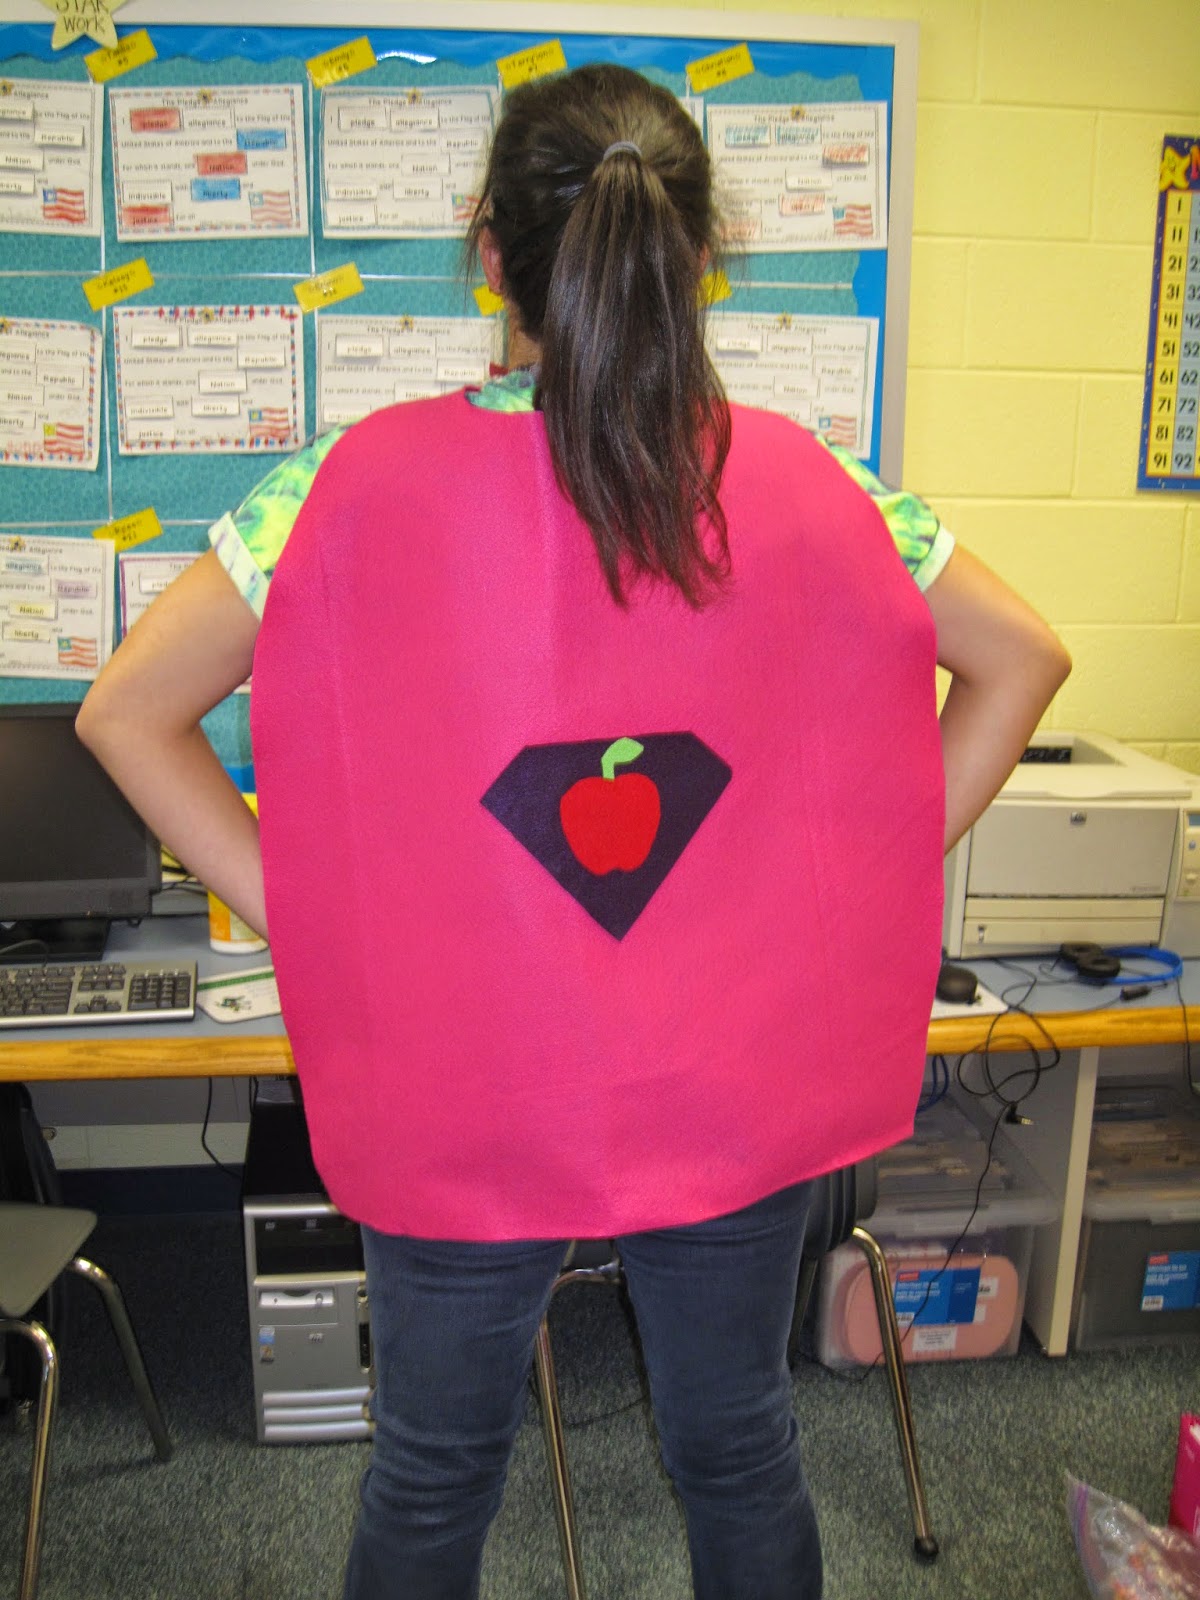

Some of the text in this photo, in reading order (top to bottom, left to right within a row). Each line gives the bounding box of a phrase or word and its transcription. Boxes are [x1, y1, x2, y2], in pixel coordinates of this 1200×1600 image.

[1178, 197, 1182, 214] 1
[1172, 226, 1182, 242] 11
[1168, 254, 1182, 272] 21
[1166, 283, 1180, 300] 31
[1164, 312, 1200, 328] 41 42
[1162, 340, 1200, 358] 51 52
[1160, 368, 1198, 386] 61 62
[1158, 396, 1196, 414] 71 72
[1156, 425, 1194, 442] 81 82
[1154, 452, 1192, 470] 91 92
